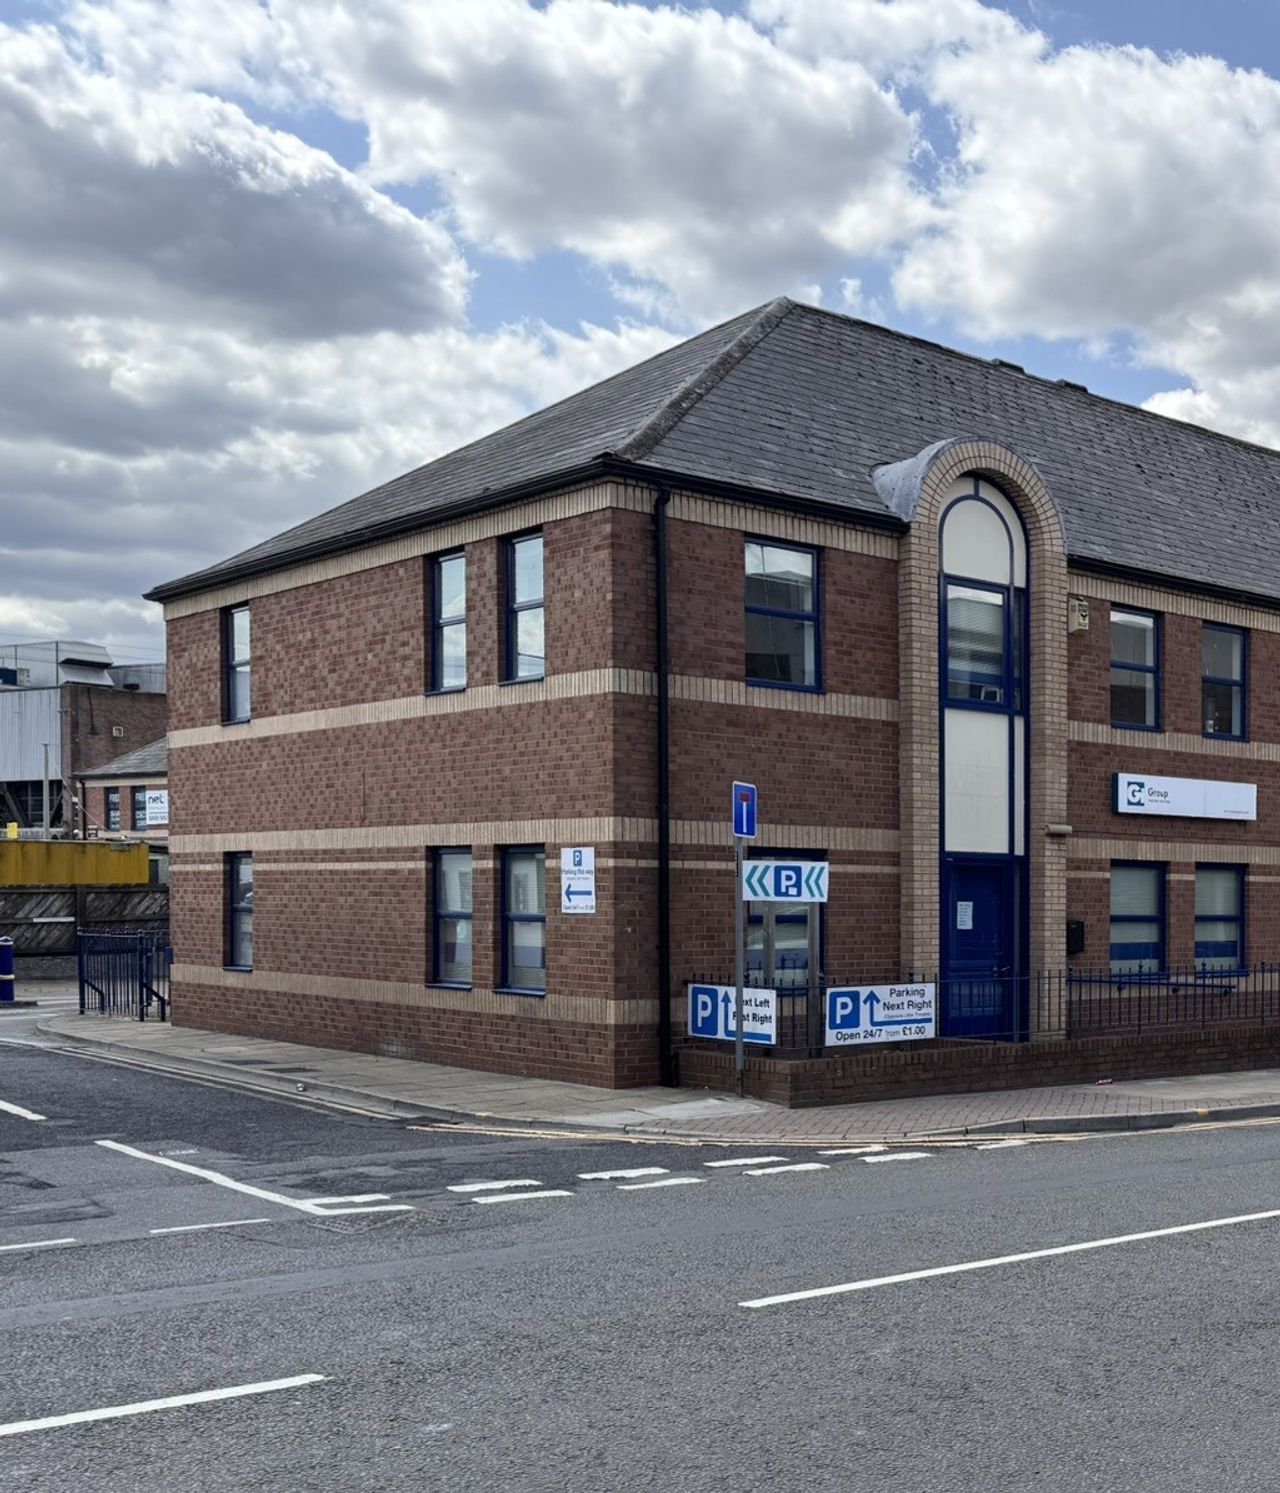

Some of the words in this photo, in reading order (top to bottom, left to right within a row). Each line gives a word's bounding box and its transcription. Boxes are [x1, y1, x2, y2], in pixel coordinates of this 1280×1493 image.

[1148, 787, 1169, 799] Group
[889, 987, 925, 998] Parking
[754, 998, 770, 1008] Left
[883, 1001, 905, 1011] Next
[907, 999, 933, 1011] Right
[752, 1012, 773, 1025] Right
[835, 1031, 861, 1042] Open
[863, 1029, 883, 1039] 24/7
[902, 1026, 926, 1036] £1.00
